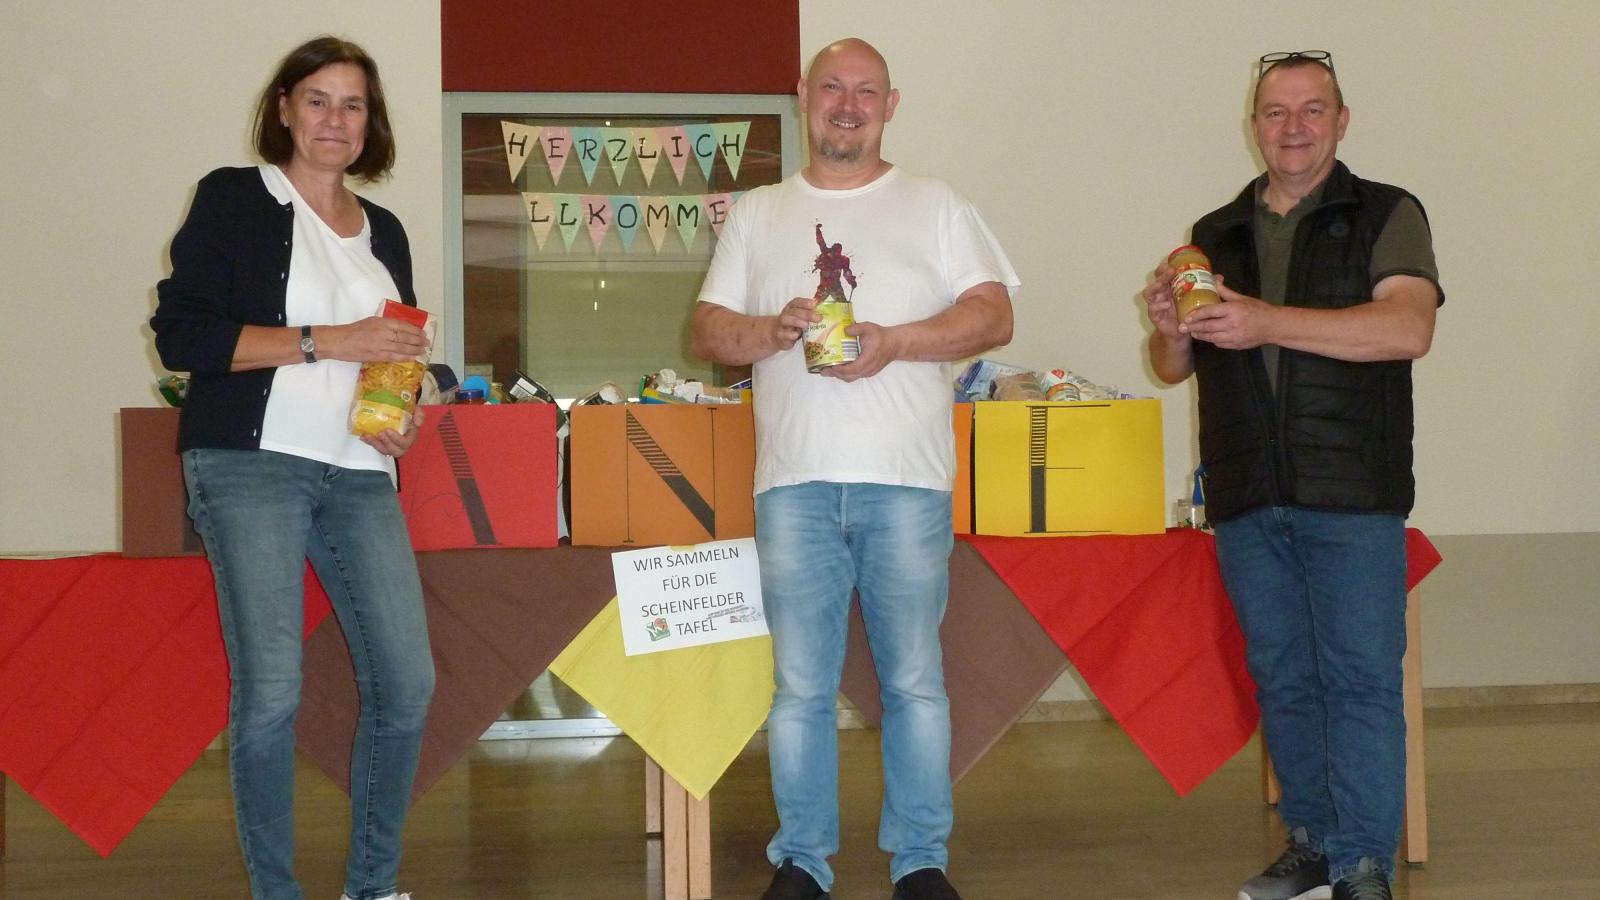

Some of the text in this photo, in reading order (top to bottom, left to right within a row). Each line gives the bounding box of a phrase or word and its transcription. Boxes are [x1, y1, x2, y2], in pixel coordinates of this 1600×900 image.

[508, 132, 740, 162] HERZLICH
[529, 201, 725, 229] LLKOMME
[633, 547, 739, 572] WIR SAMMELN
[662, 572, 718, 591] FÜR DIE
[641, 591, 745, 617] SCHEINFELDER
[675, 619, 718, 636] TAFEL
